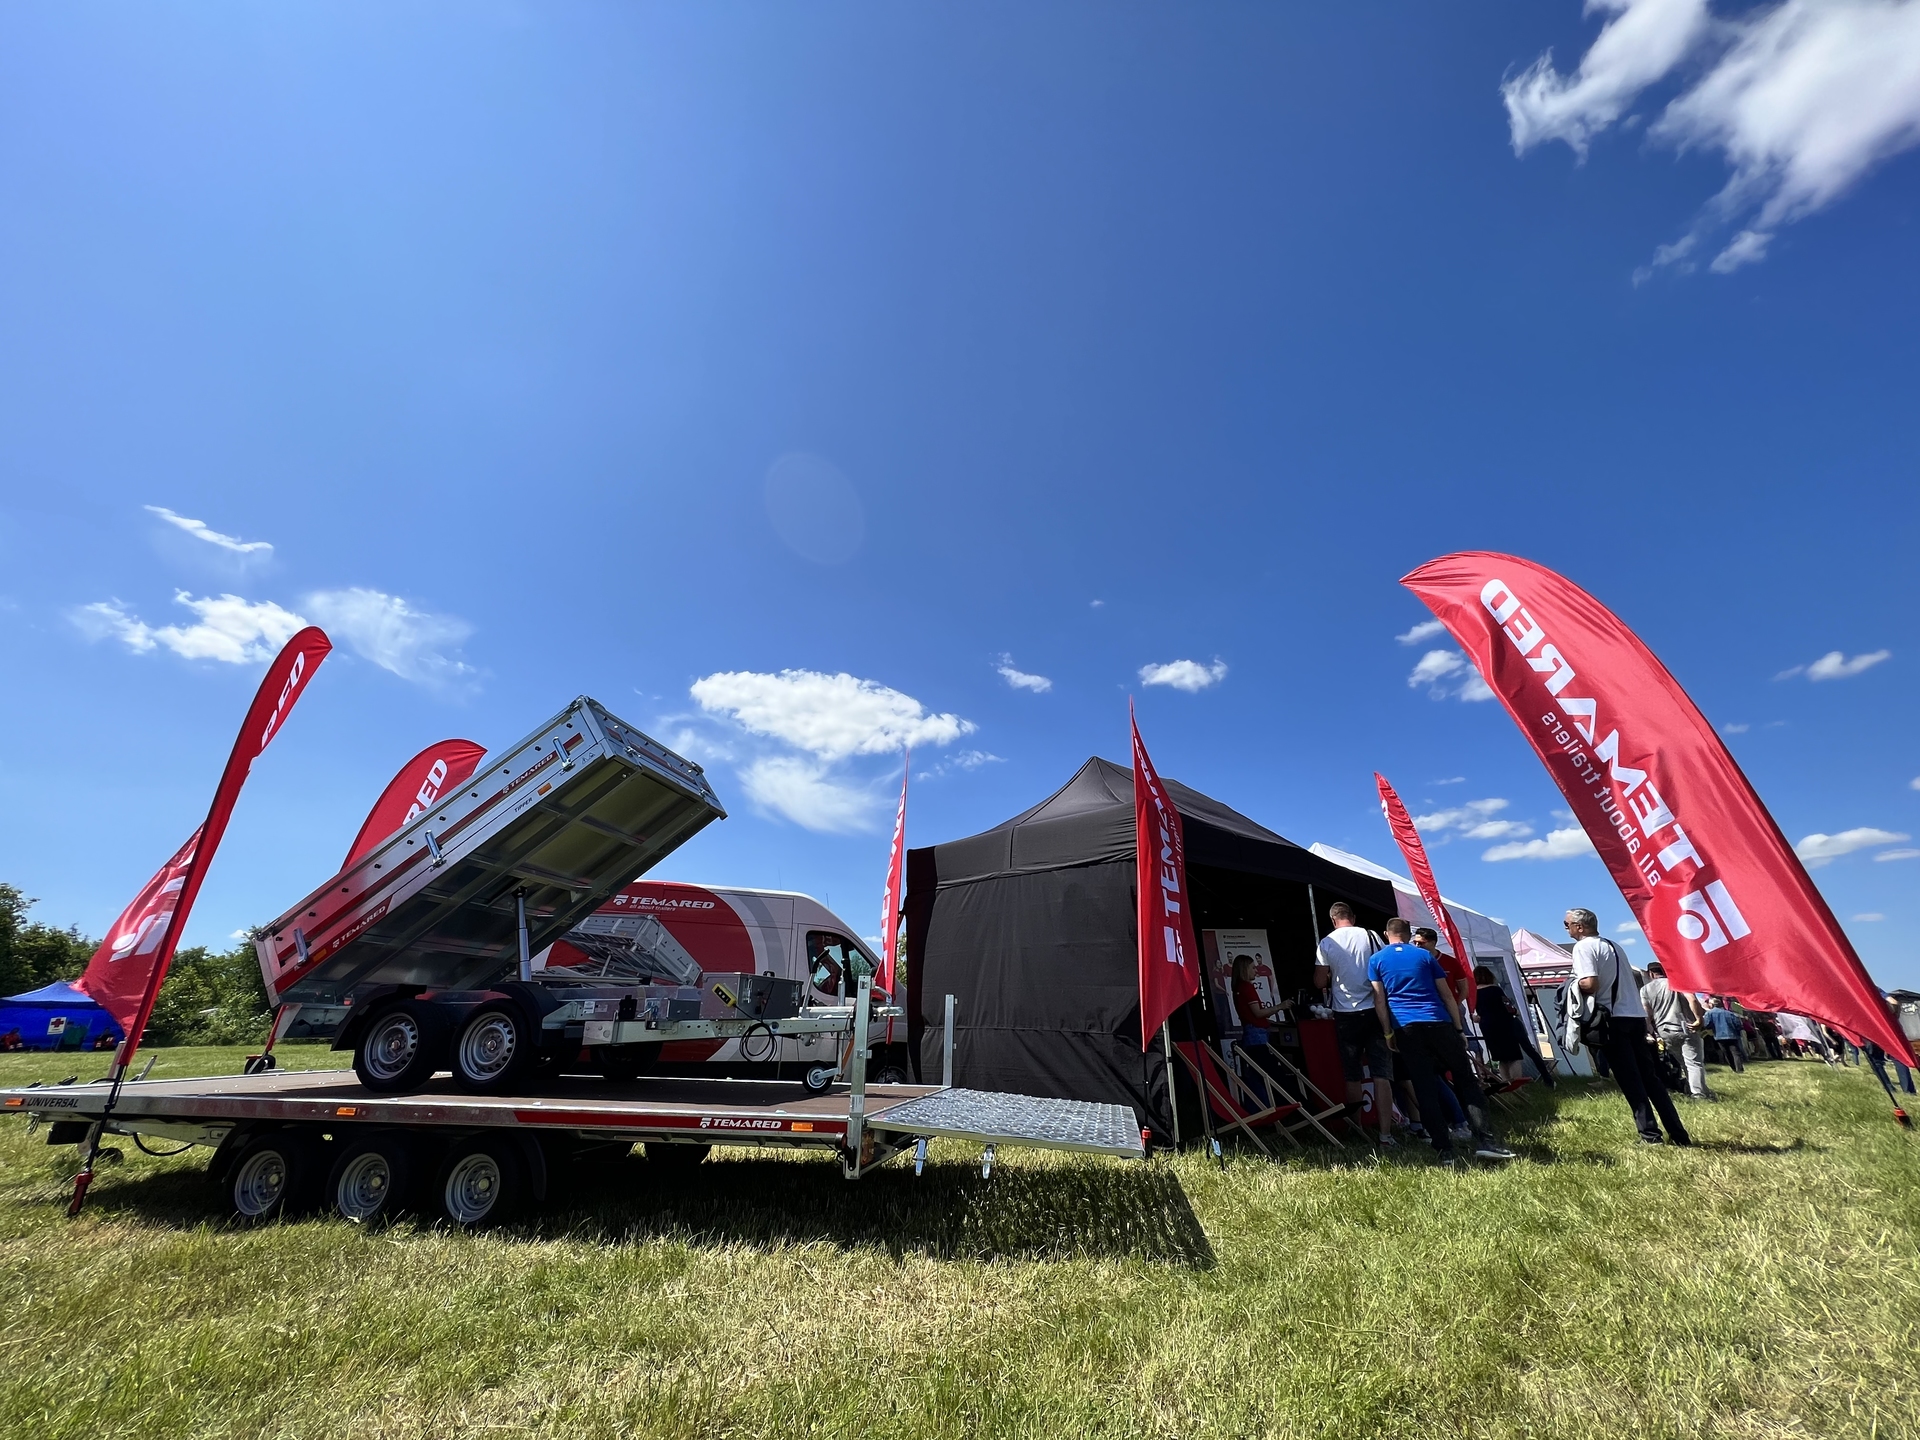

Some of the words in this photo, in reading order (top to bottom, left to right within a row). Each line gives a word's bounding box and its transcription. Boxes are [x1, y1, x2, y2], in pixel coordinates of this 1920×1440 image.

[510, 754, 553, 787] TEMARED
[514, 797, 533, 813] TIPPER
[631, 896, 715, 909] TEMARED
[341, 905, 386, 941] TEMARED
[27, 1097, 80, 1108] UNIVERSAL
[713, 1118, 782, 1129] TEMARED
